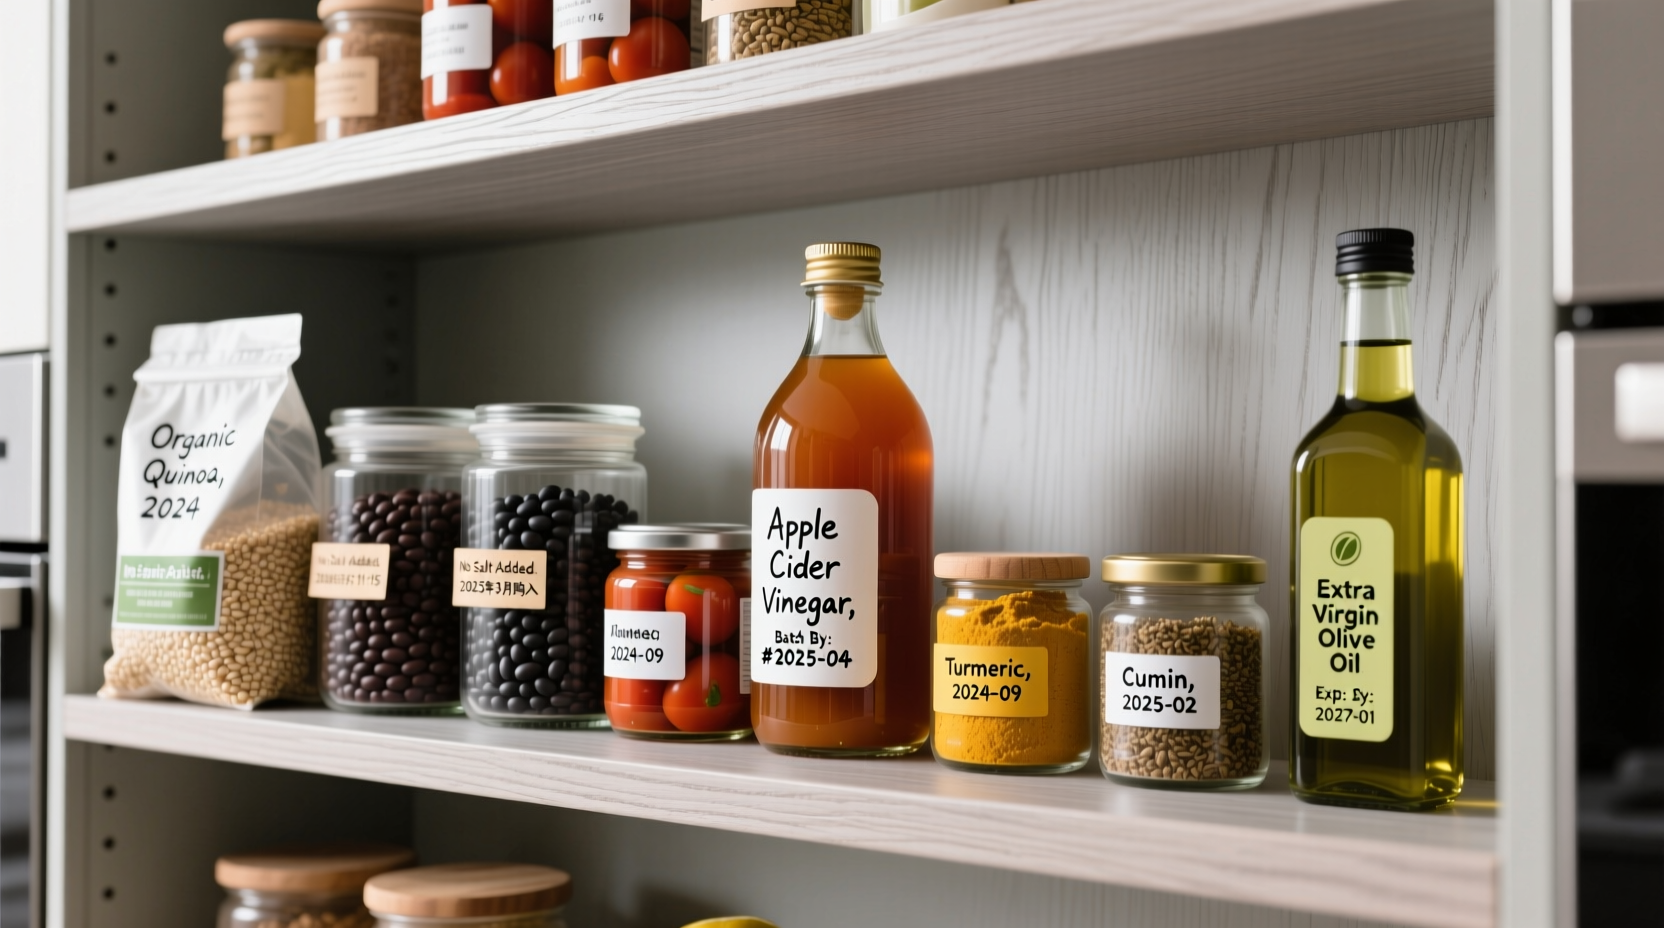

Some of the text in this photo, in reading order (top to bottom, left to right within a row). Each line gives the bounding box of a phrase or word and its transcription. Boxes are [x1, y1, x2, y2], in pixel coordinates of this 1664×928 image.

[150, 423, 236, 460] Organic
[143, 458, 224, 489] Quinoa,
[140, 495, 201, 520] 2024
[767, 506, 839, 550] Apple
[459, 560, 472, 573] No
[473, 559, 493, 574] Salt
[769, 549, 841, 580] Cider
[1317, 578, 1376, 601] Extra
[762, 586, 856, 627] Vinegar,
[1311, 603, 1380, 631] Virgin
[809, 630, 833, 650] By:
[1317, 627, 1377, 650] Olive
[610, 646, 665, 664] 2024-09
[761, 646, 853, 669] #2025-04
[1329, 652, 1361, 674] Oil
[944, 657, 1032, 682] Turmeric,
[1122, 666, 1195, 694] Cumin,
[952, 683, 1023, 702] 2024-09
[1122, 694, 1198, 714] 2025-02
[1315, 685, 1347, 705] Exp:
[1315, 707, 1375, 725] 2027-01
